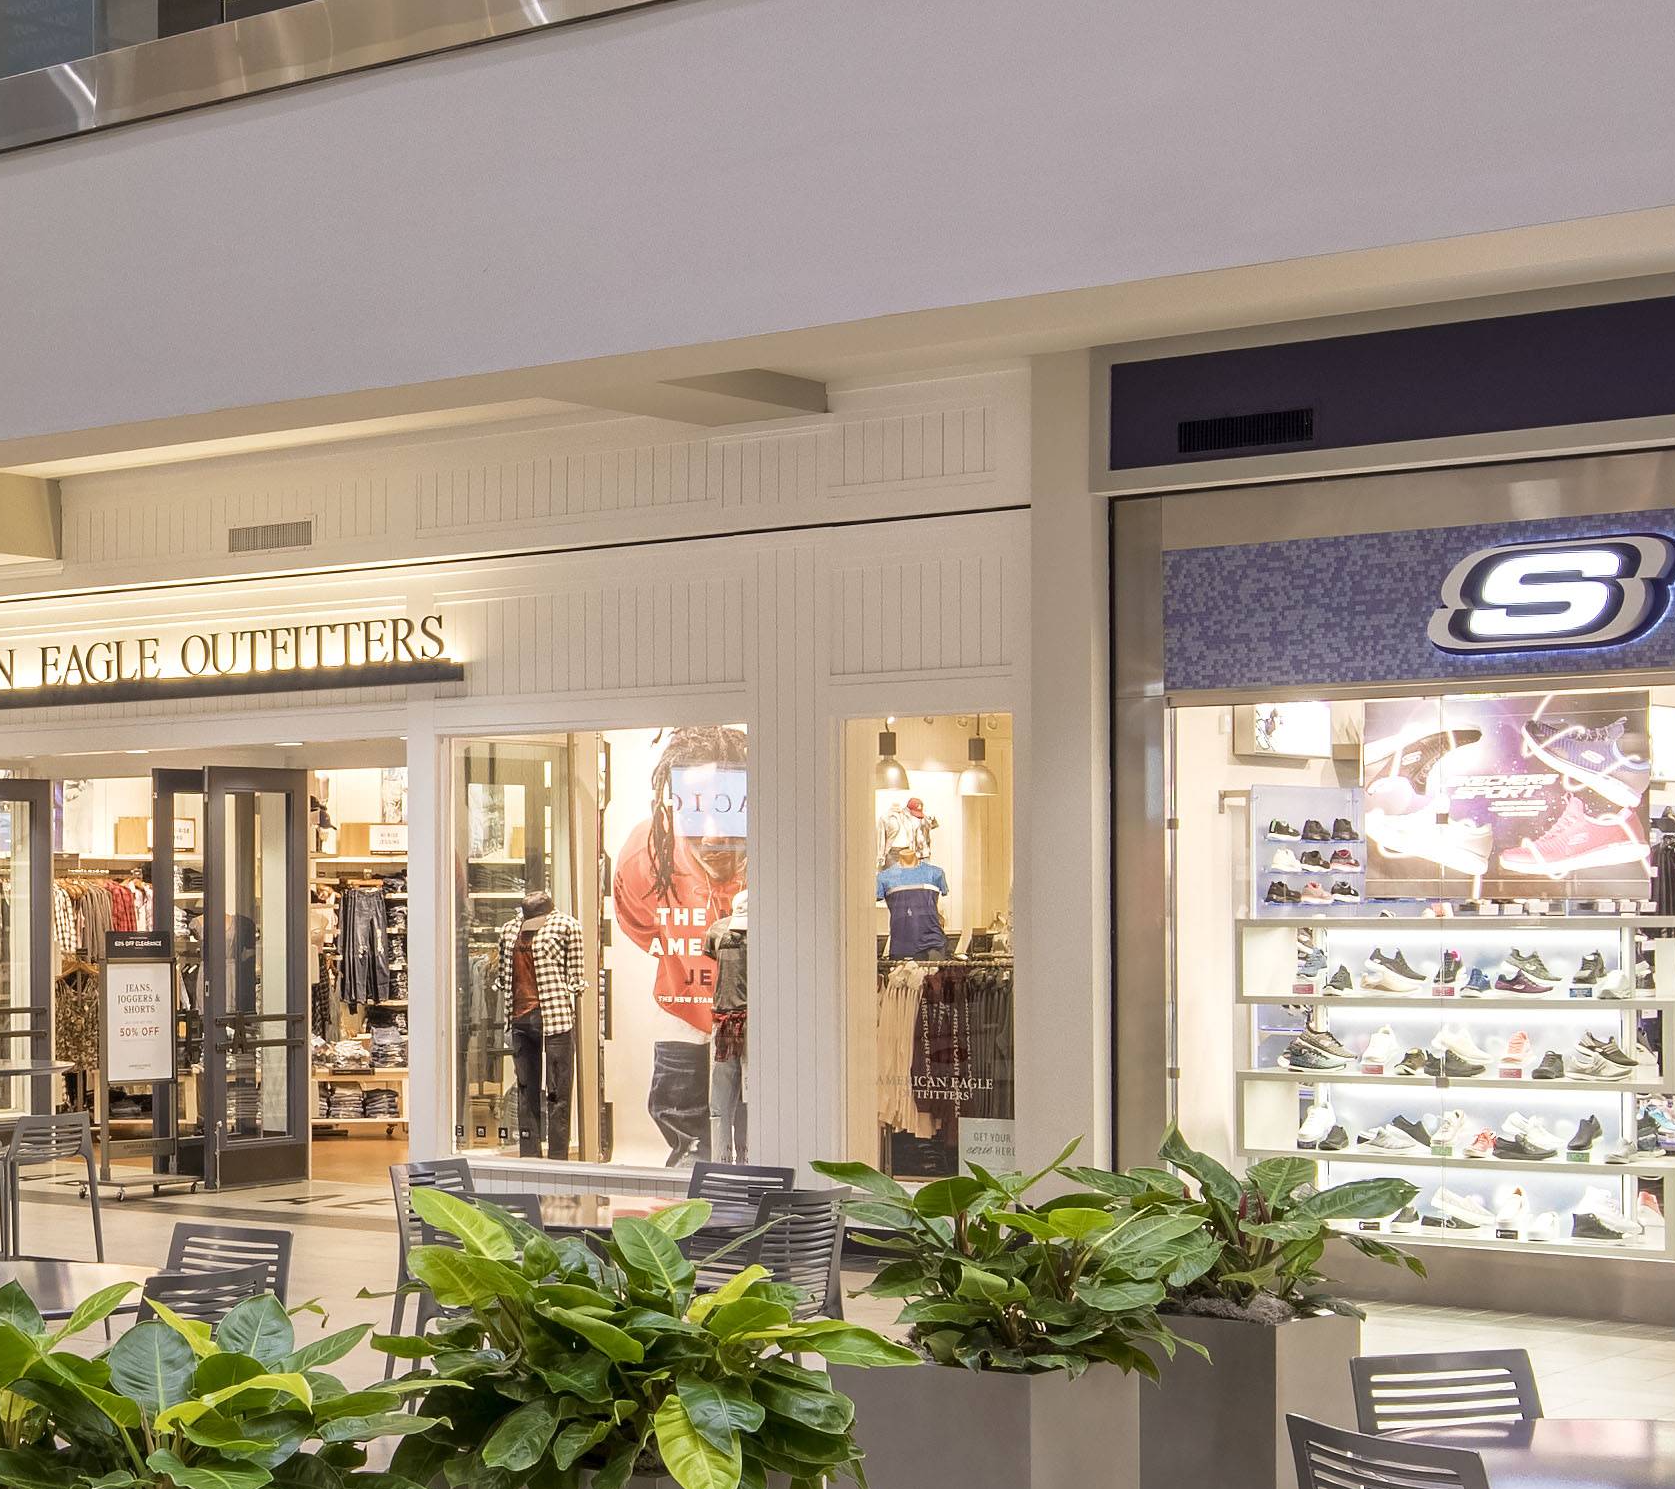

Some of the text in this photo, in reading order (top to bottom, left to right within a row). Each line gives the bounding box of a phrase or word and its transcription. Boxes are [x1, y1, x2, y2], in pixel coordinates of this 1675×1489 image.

[38, 637, 162, 687] EAGLE
[180, 614, 446, 677] OUTFITTERS
[656, 907, 707, 926] THE
[648, 937, 703, 956] AME
[684, 969, 713, 986] JE
[125, 983, 153, 993] JEANS,
[117, 993, 161, 1004] JOGGERS &
[123, 1004, 156, 1014] SHORTS
[119, 1026, 160, 1037] 50% OFF
[876, 1075, 994, 1090] AMERICAN EAGLE
[973, 1133, 1011, 1143] GET YOUR
